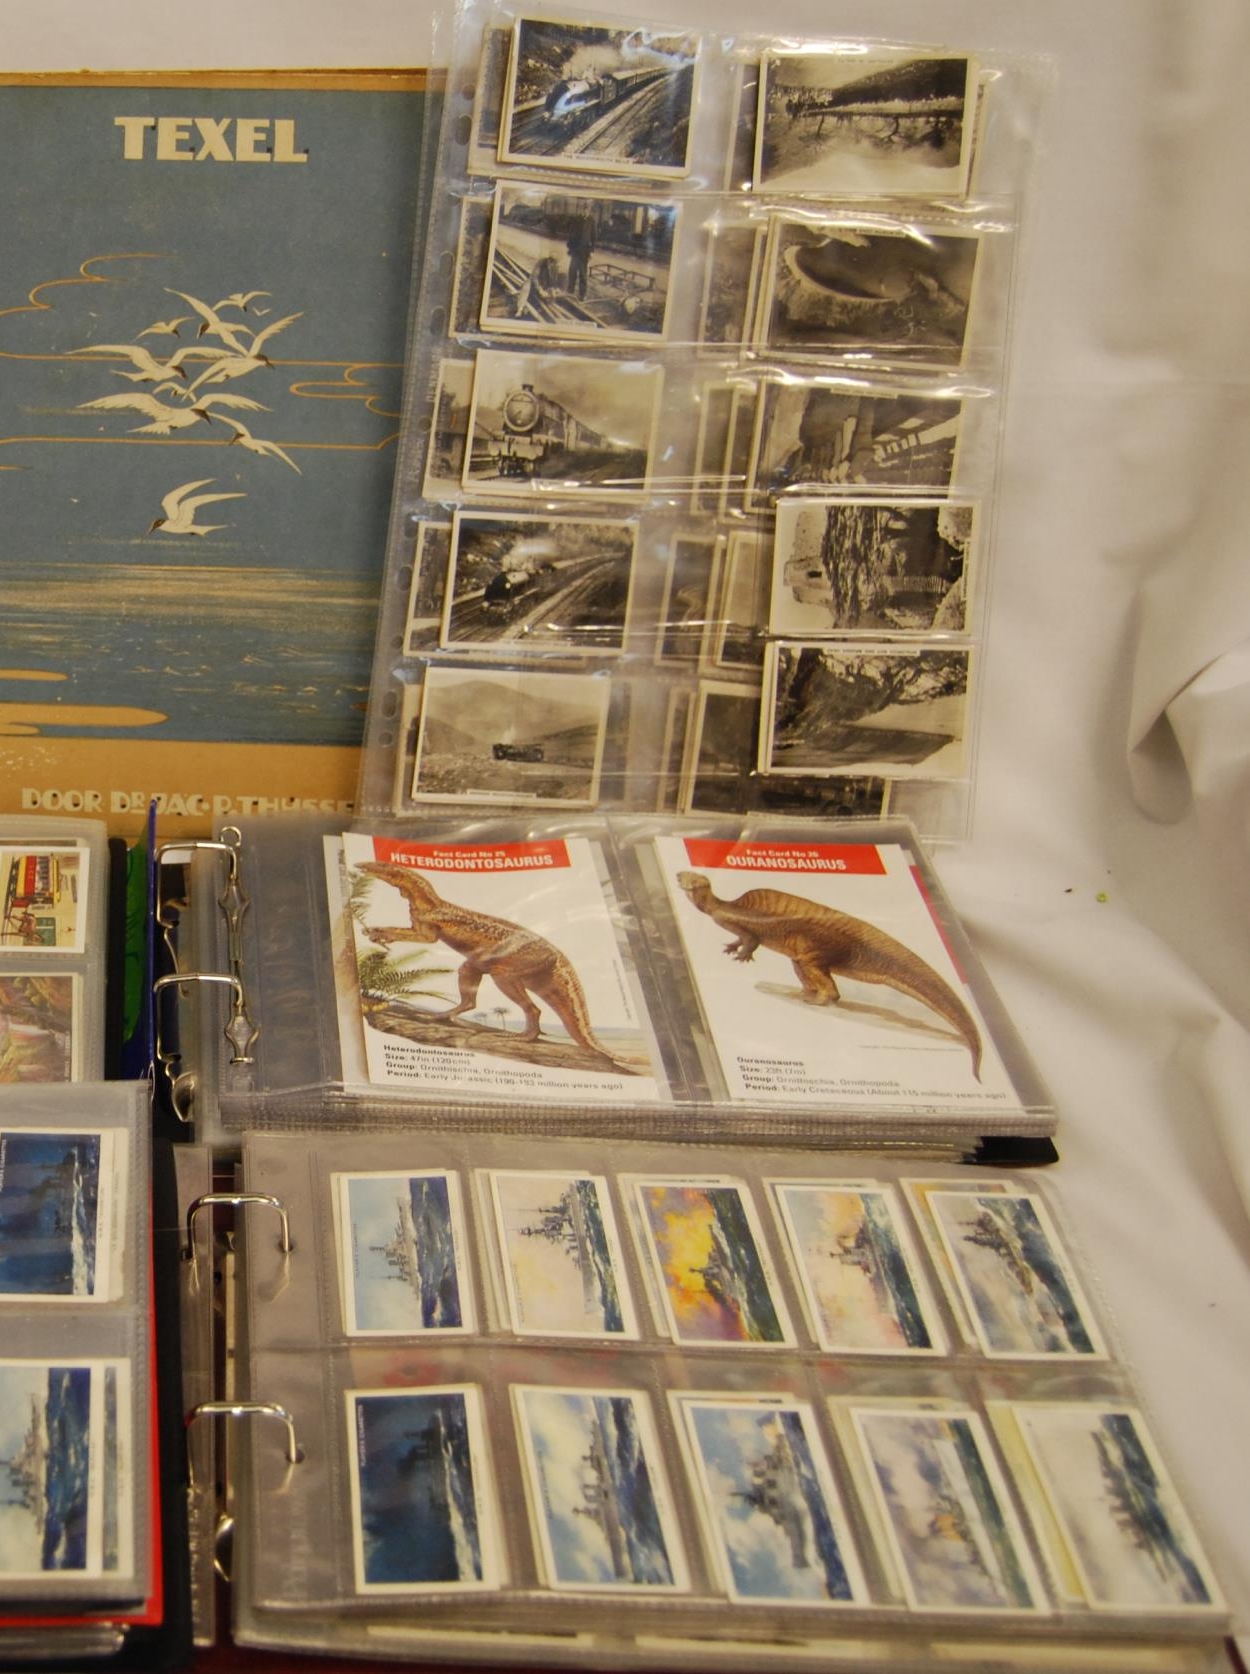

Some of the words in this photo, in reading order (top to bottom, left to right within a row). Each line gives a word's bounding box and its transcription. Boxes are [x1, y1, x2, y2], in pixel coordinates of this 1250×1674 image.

[114, 116, 308, 163] TEXEL
[21, 787, 103, 813] DOOR
[433, 850, 454, 858] Fact
[455, 851, 478, 859] Card
[495, 850, 506, 858] 25
[745, 848, 767, 857] Fact
[768, 849, 790, 858] Card
[792, 850, 807, 858] No
[390, 852, 553, 869] HETERODONTOSAURUS
[725, 854, 847, 871] OURANOSAURUS
[383, 1044, 476, 1058] Heterodontosaurus
[384, 1053, 408, 1062] Size:
[736, 1055, 804, 1067] Ouranosaurus
[385, 1061, 417, 1072] Group:
[739, 1065, 763, 1074] Size:
[387, 1070, 421, 1079] Period:
[424, 1073, 449, 1082] Early
[537, 1080, 570, 1089] million
[572, 1082, 599, 1091] years
[600, 1082, 623, 1092] ago)
[742, 1074, 774, 1083] Group:
[744, 1083, 779, 1092] Period:
[782, 1084, 807, 1094] Early
